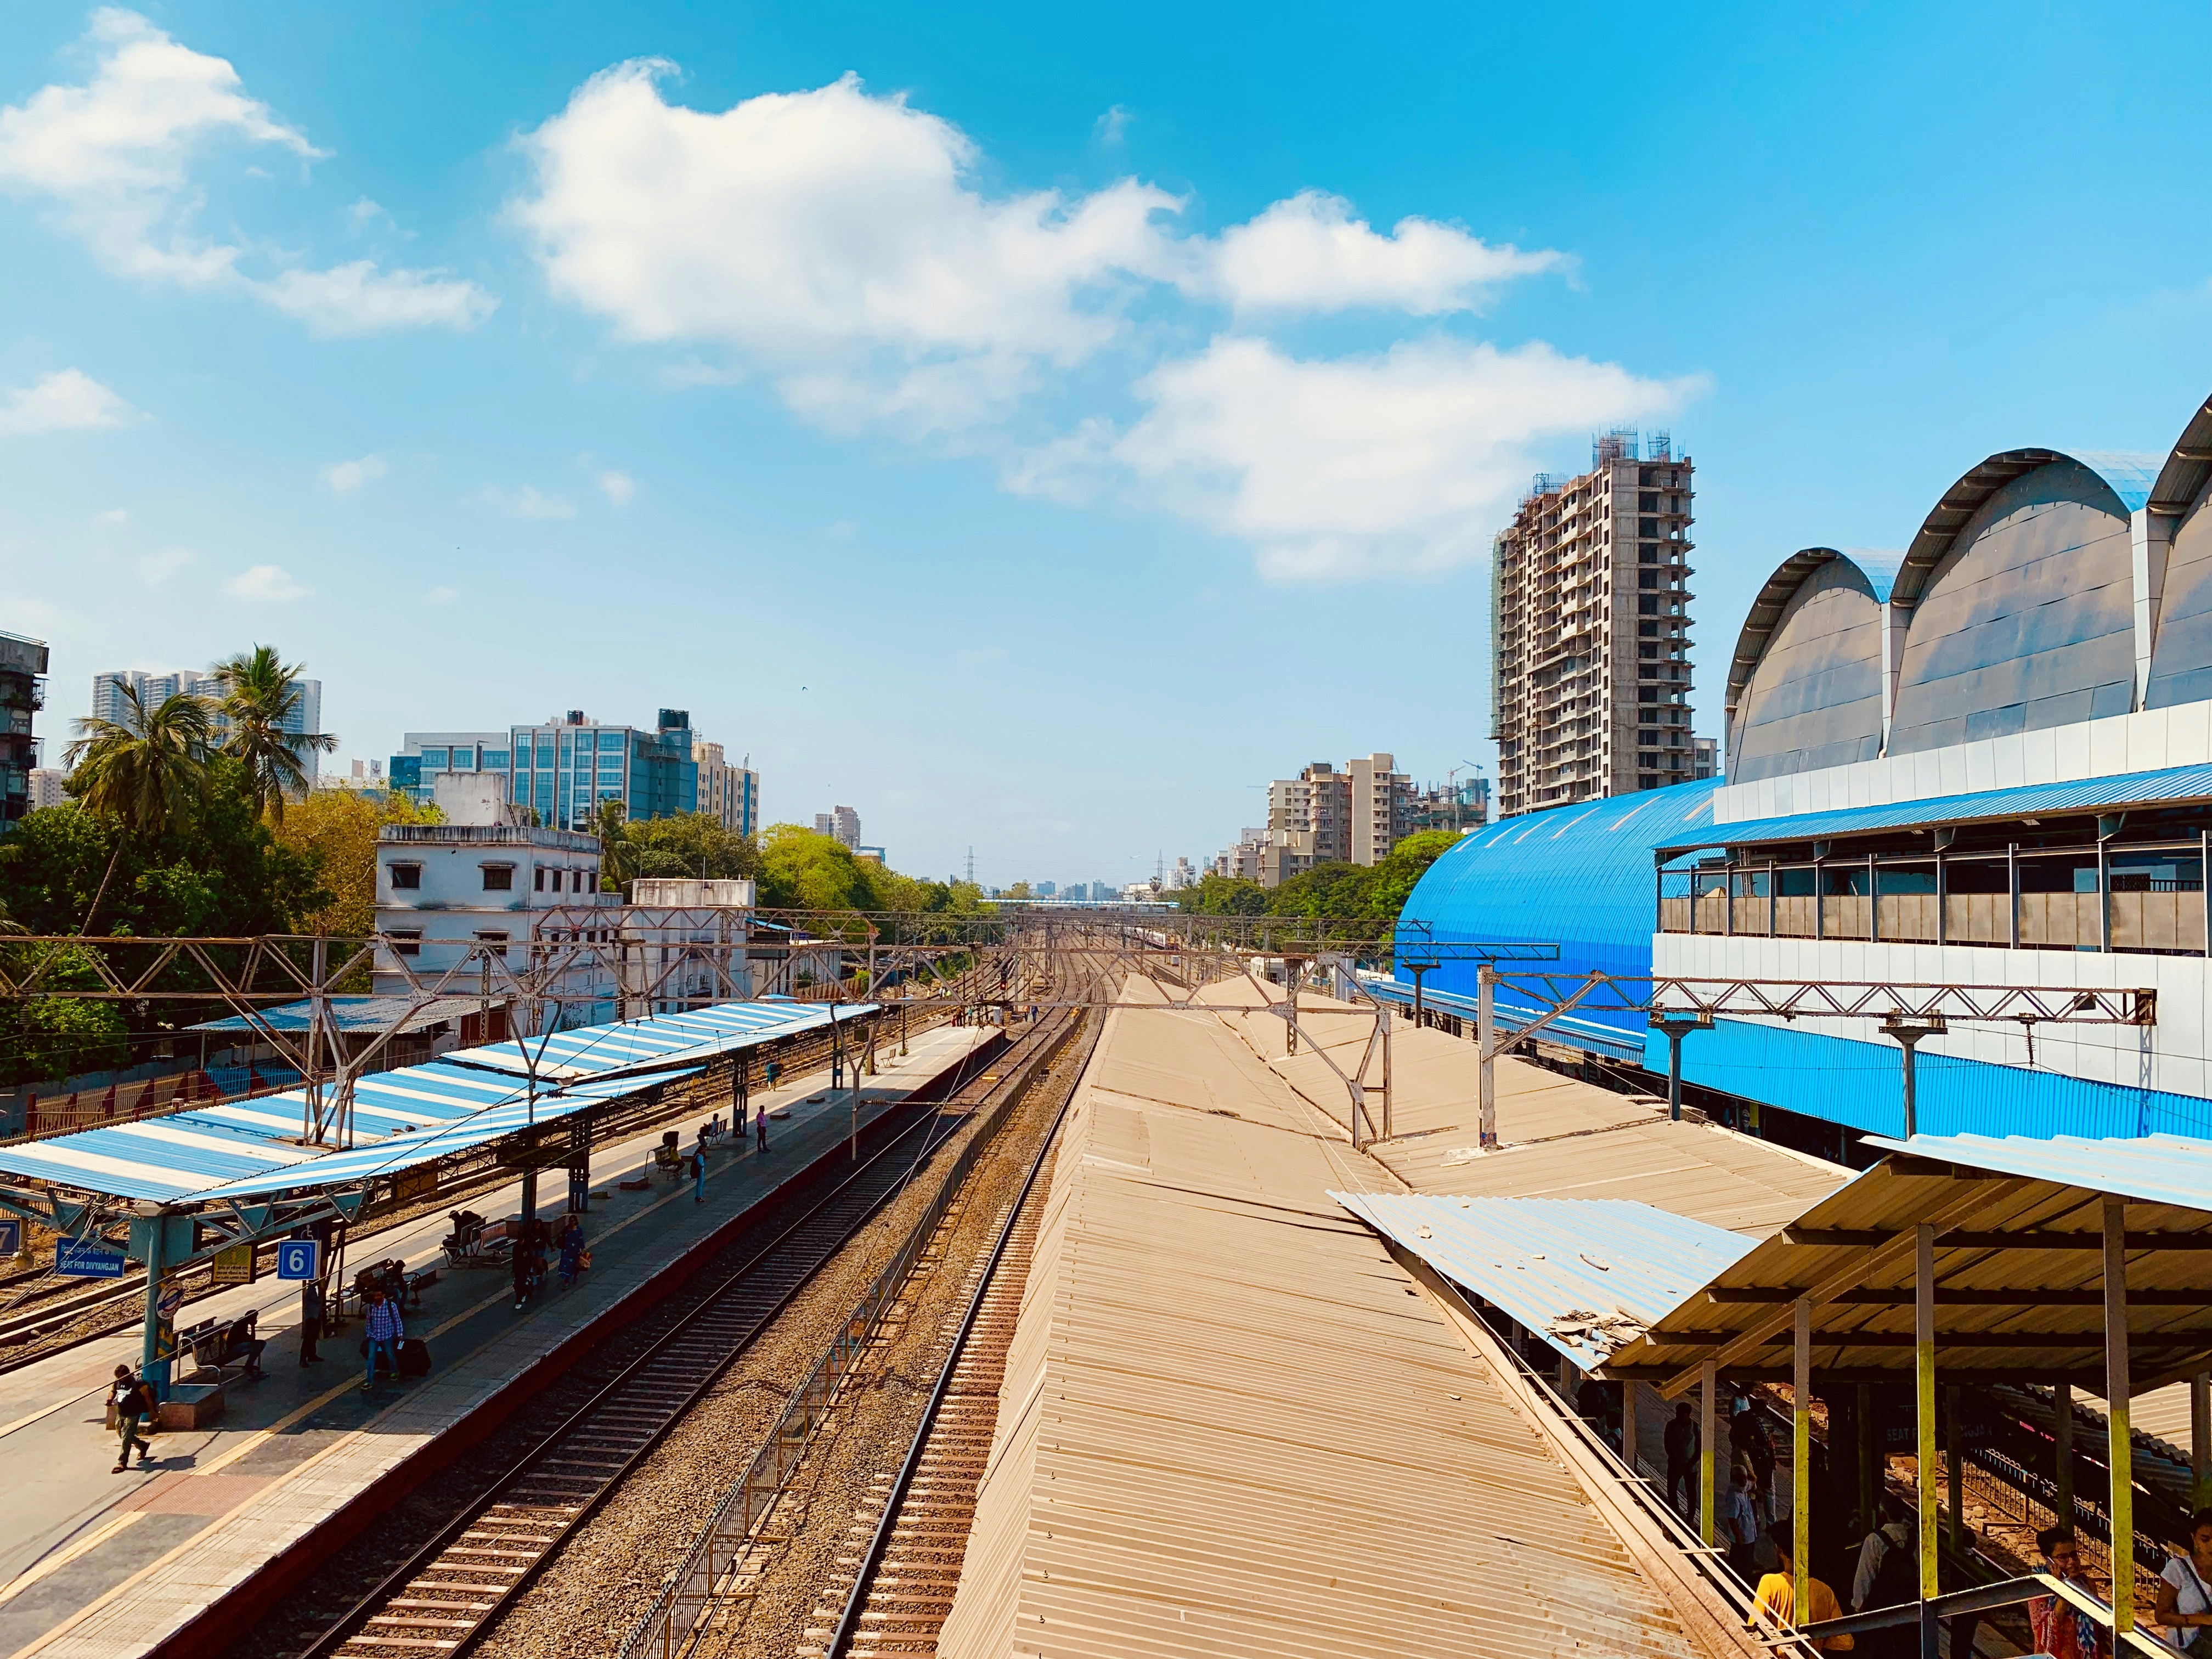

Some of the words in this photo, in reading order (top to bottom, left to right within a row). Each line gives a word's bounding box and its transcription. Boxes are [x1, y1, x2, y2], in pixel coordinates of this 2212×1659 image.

[0, 1227, 10, 1250] 7
[74, 1261, 84, 1269] FOR
[86, 1262, 119, 1271] DIVYANGJAN
[289, 1249, 304, 1272] 6
[1886, 1427, 1909, 1441] SEAT
